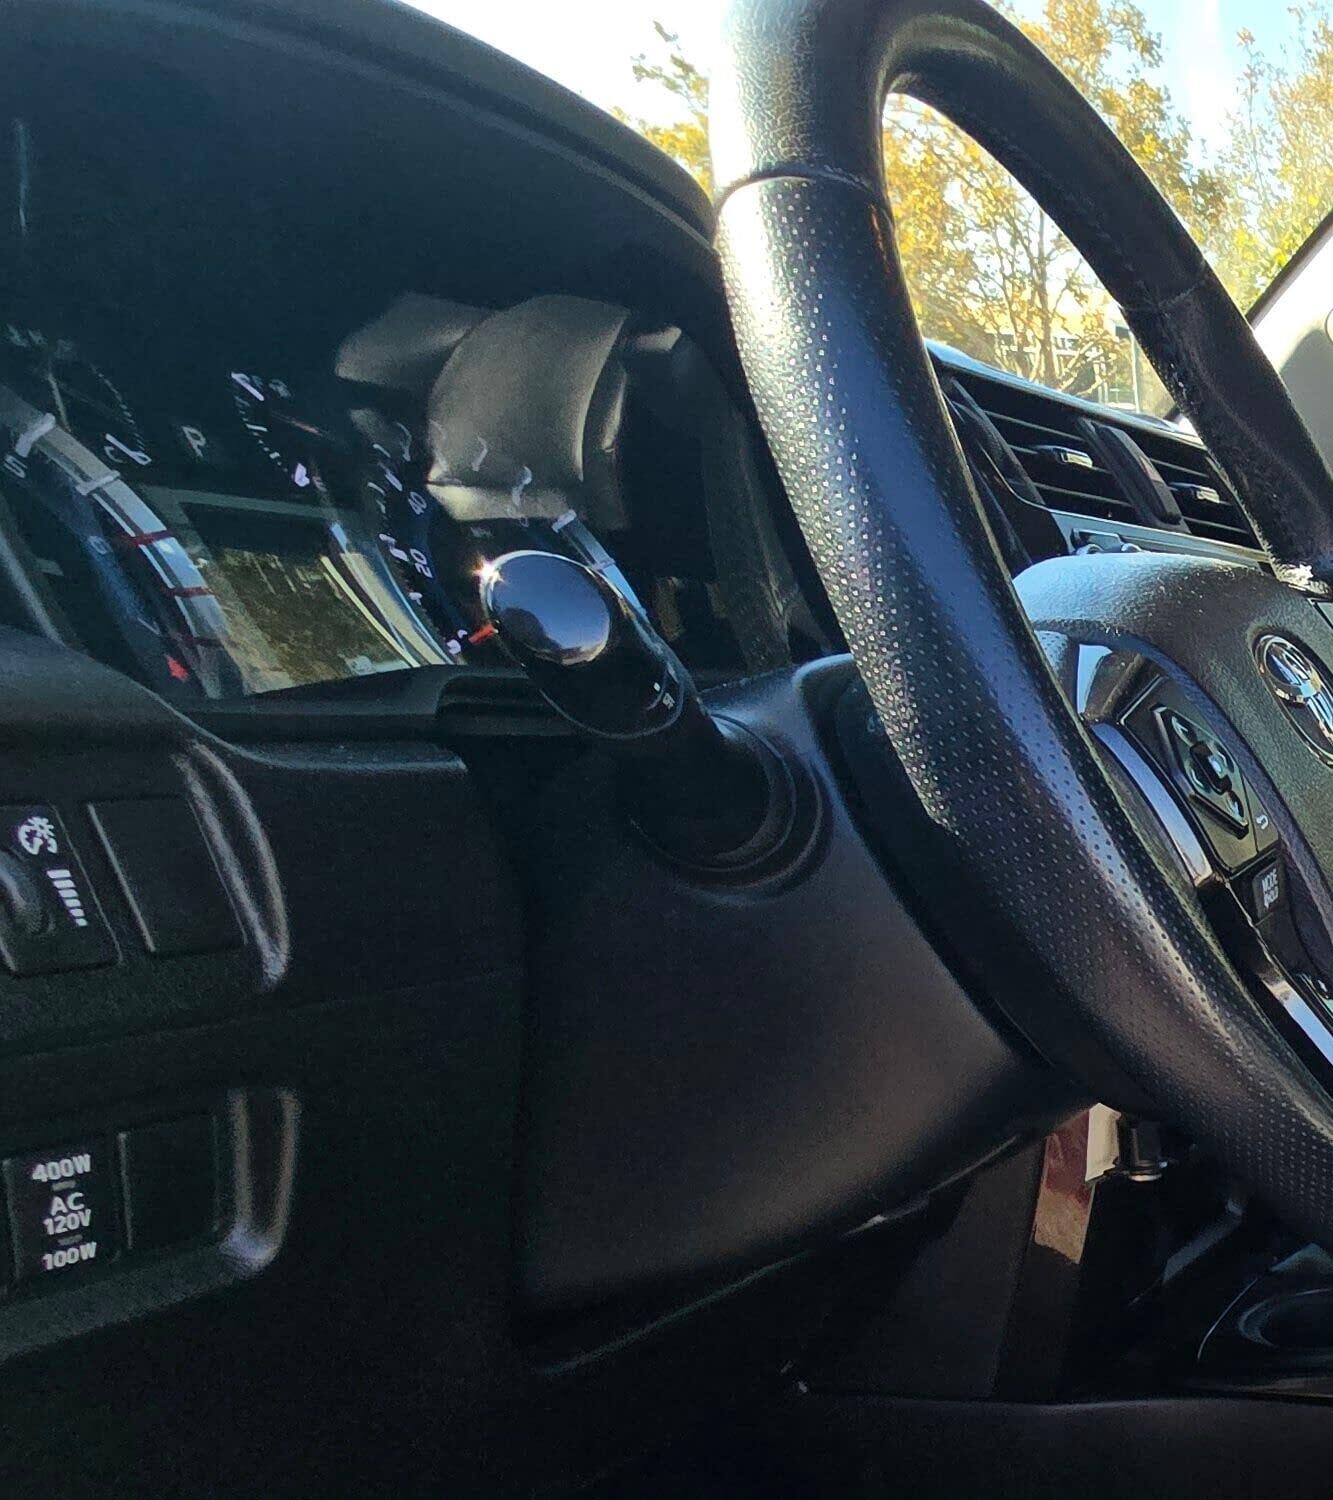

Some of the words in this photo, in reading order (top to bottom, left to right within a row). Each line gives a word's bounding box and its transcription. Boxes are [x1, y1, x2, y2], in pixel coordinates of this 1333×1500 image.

[409, 548, 433, 579] 20
[32, 1153, 91, 1182] 400W
[51, 1192, 85, 1216] AC
[43, 1209, 92, 1235] 120V
[42, 1241, 97, 1270] 100W
